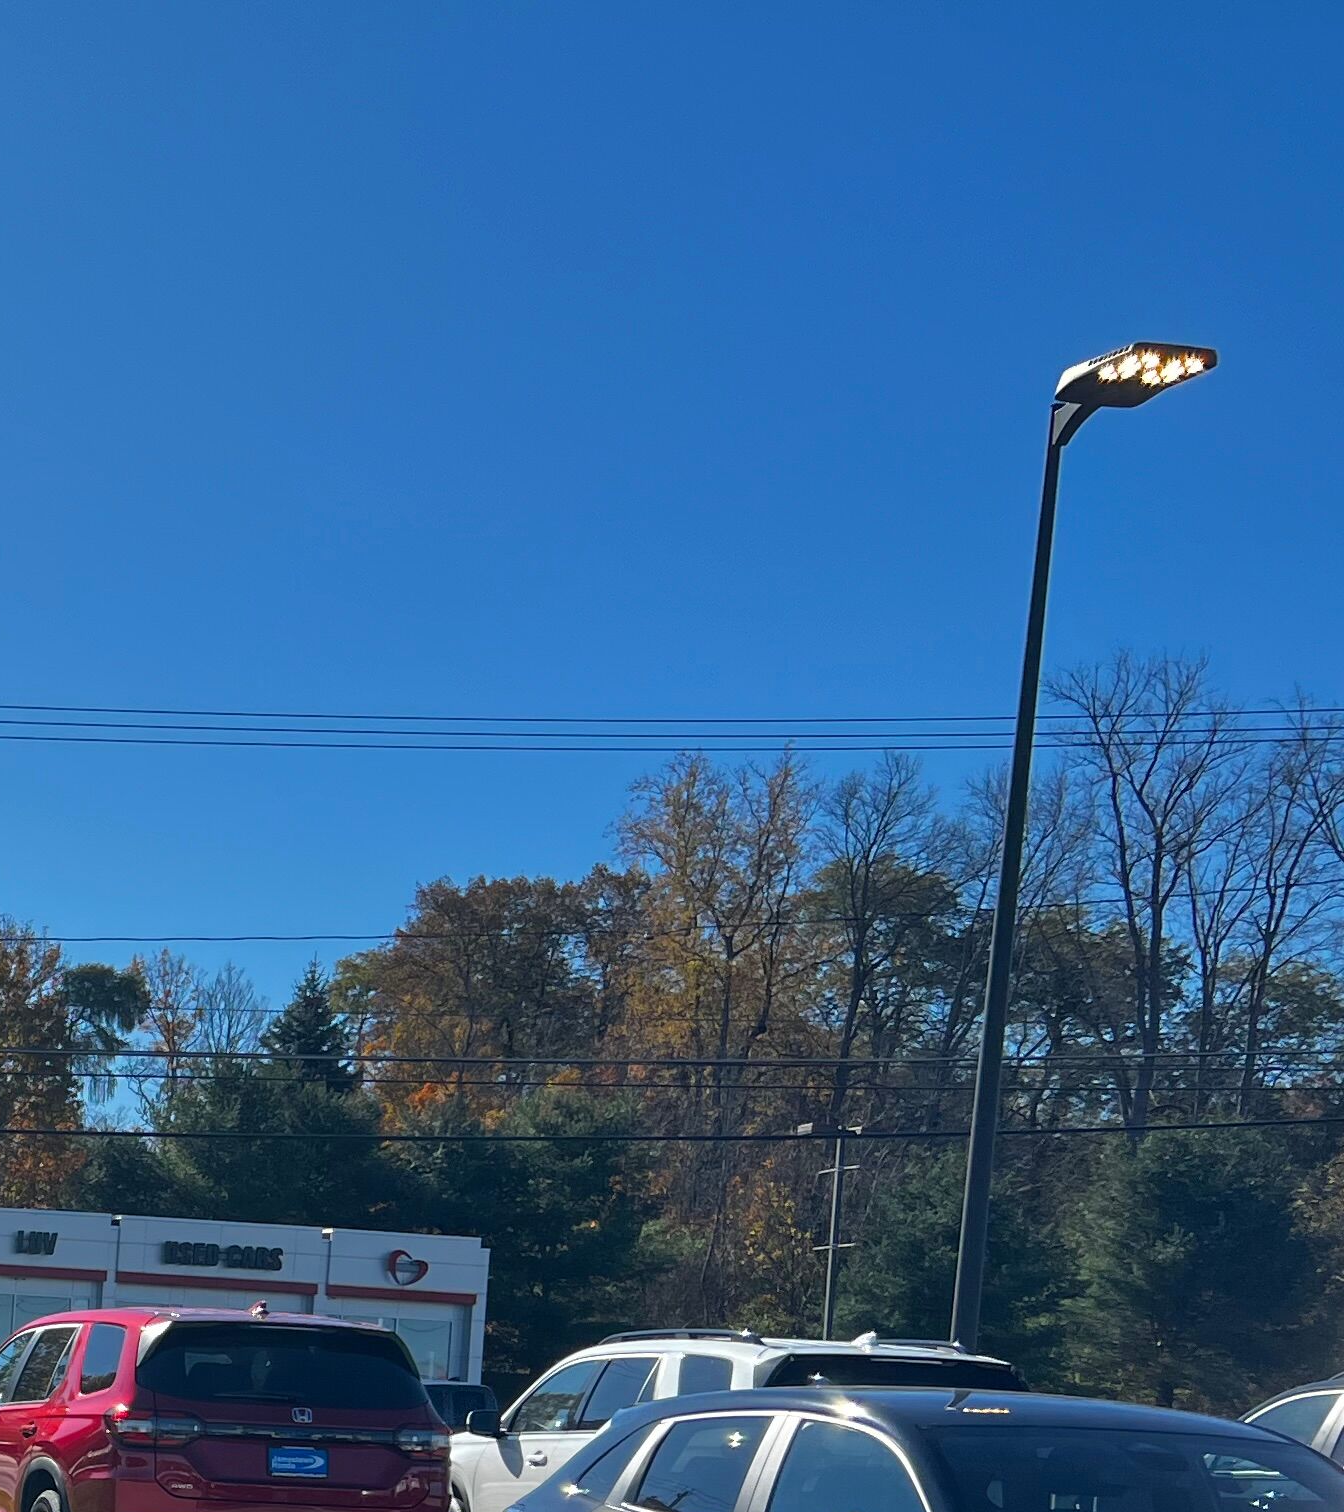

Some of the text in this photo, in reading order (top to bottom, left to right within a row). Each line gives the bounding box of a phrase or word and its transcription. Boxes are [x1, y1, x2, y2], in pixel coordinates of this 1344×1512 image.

[15, 1230, 59, 1255] LUV
[163, 1240, 284, 1271] USED CARS
